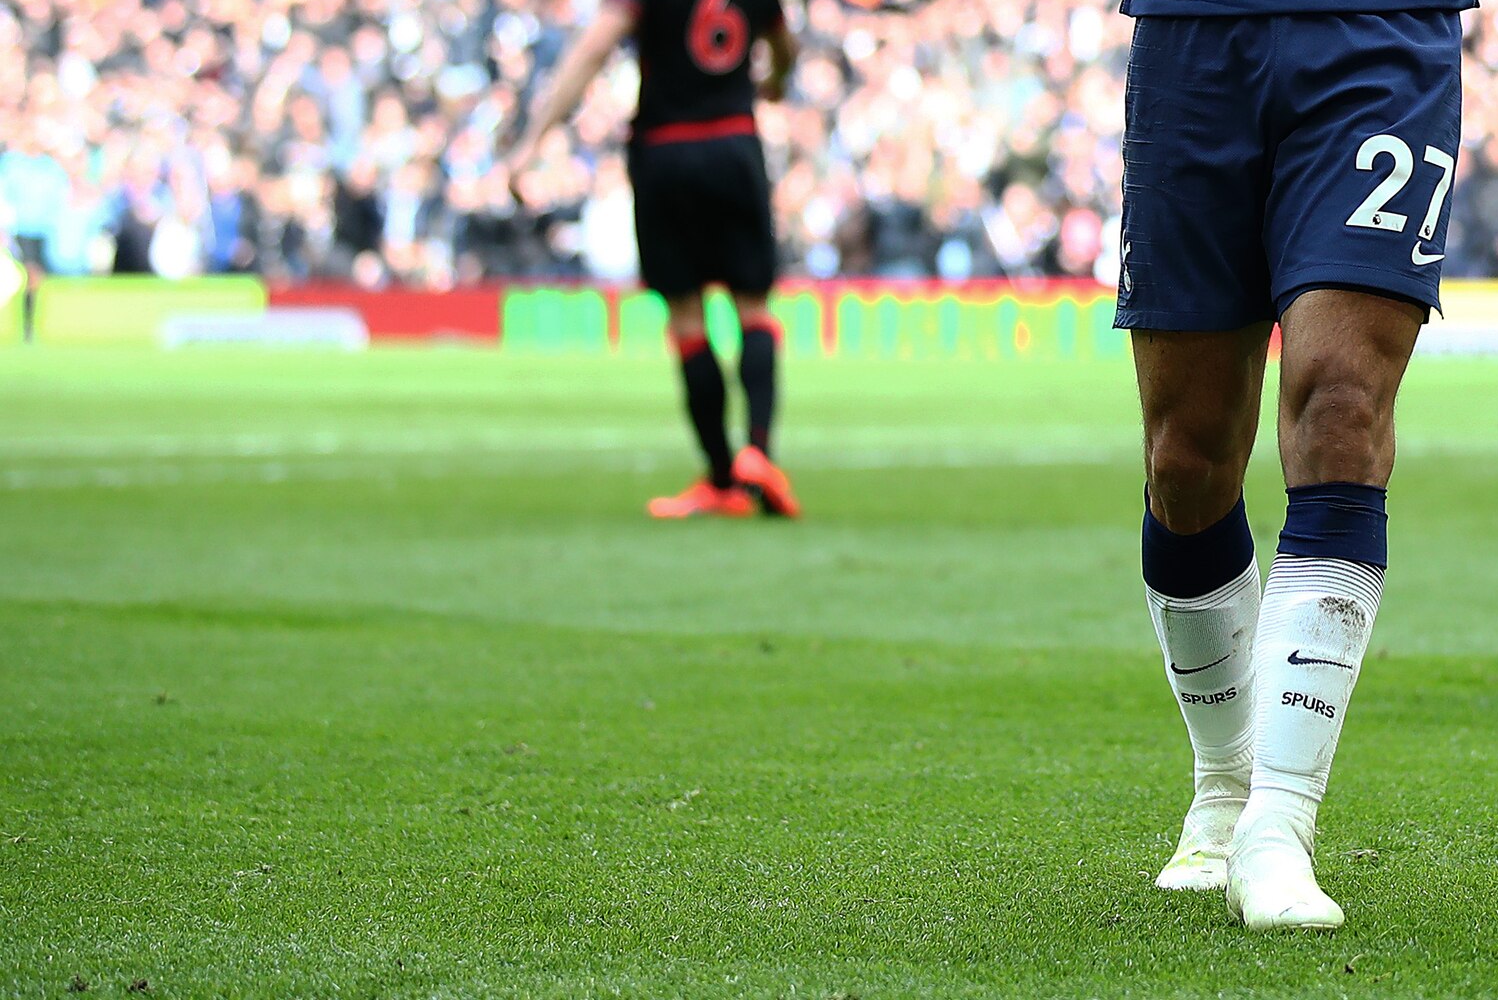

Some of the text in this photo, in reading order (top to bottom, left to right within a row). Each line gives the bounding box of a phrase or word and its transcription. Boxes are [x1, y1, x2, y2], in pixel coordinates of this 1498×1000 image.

[1346, 134, 1454, 241] 27
[1181, 687, 1237, 704] SPURS
[1281, 691, 1335, 719] SPURS
